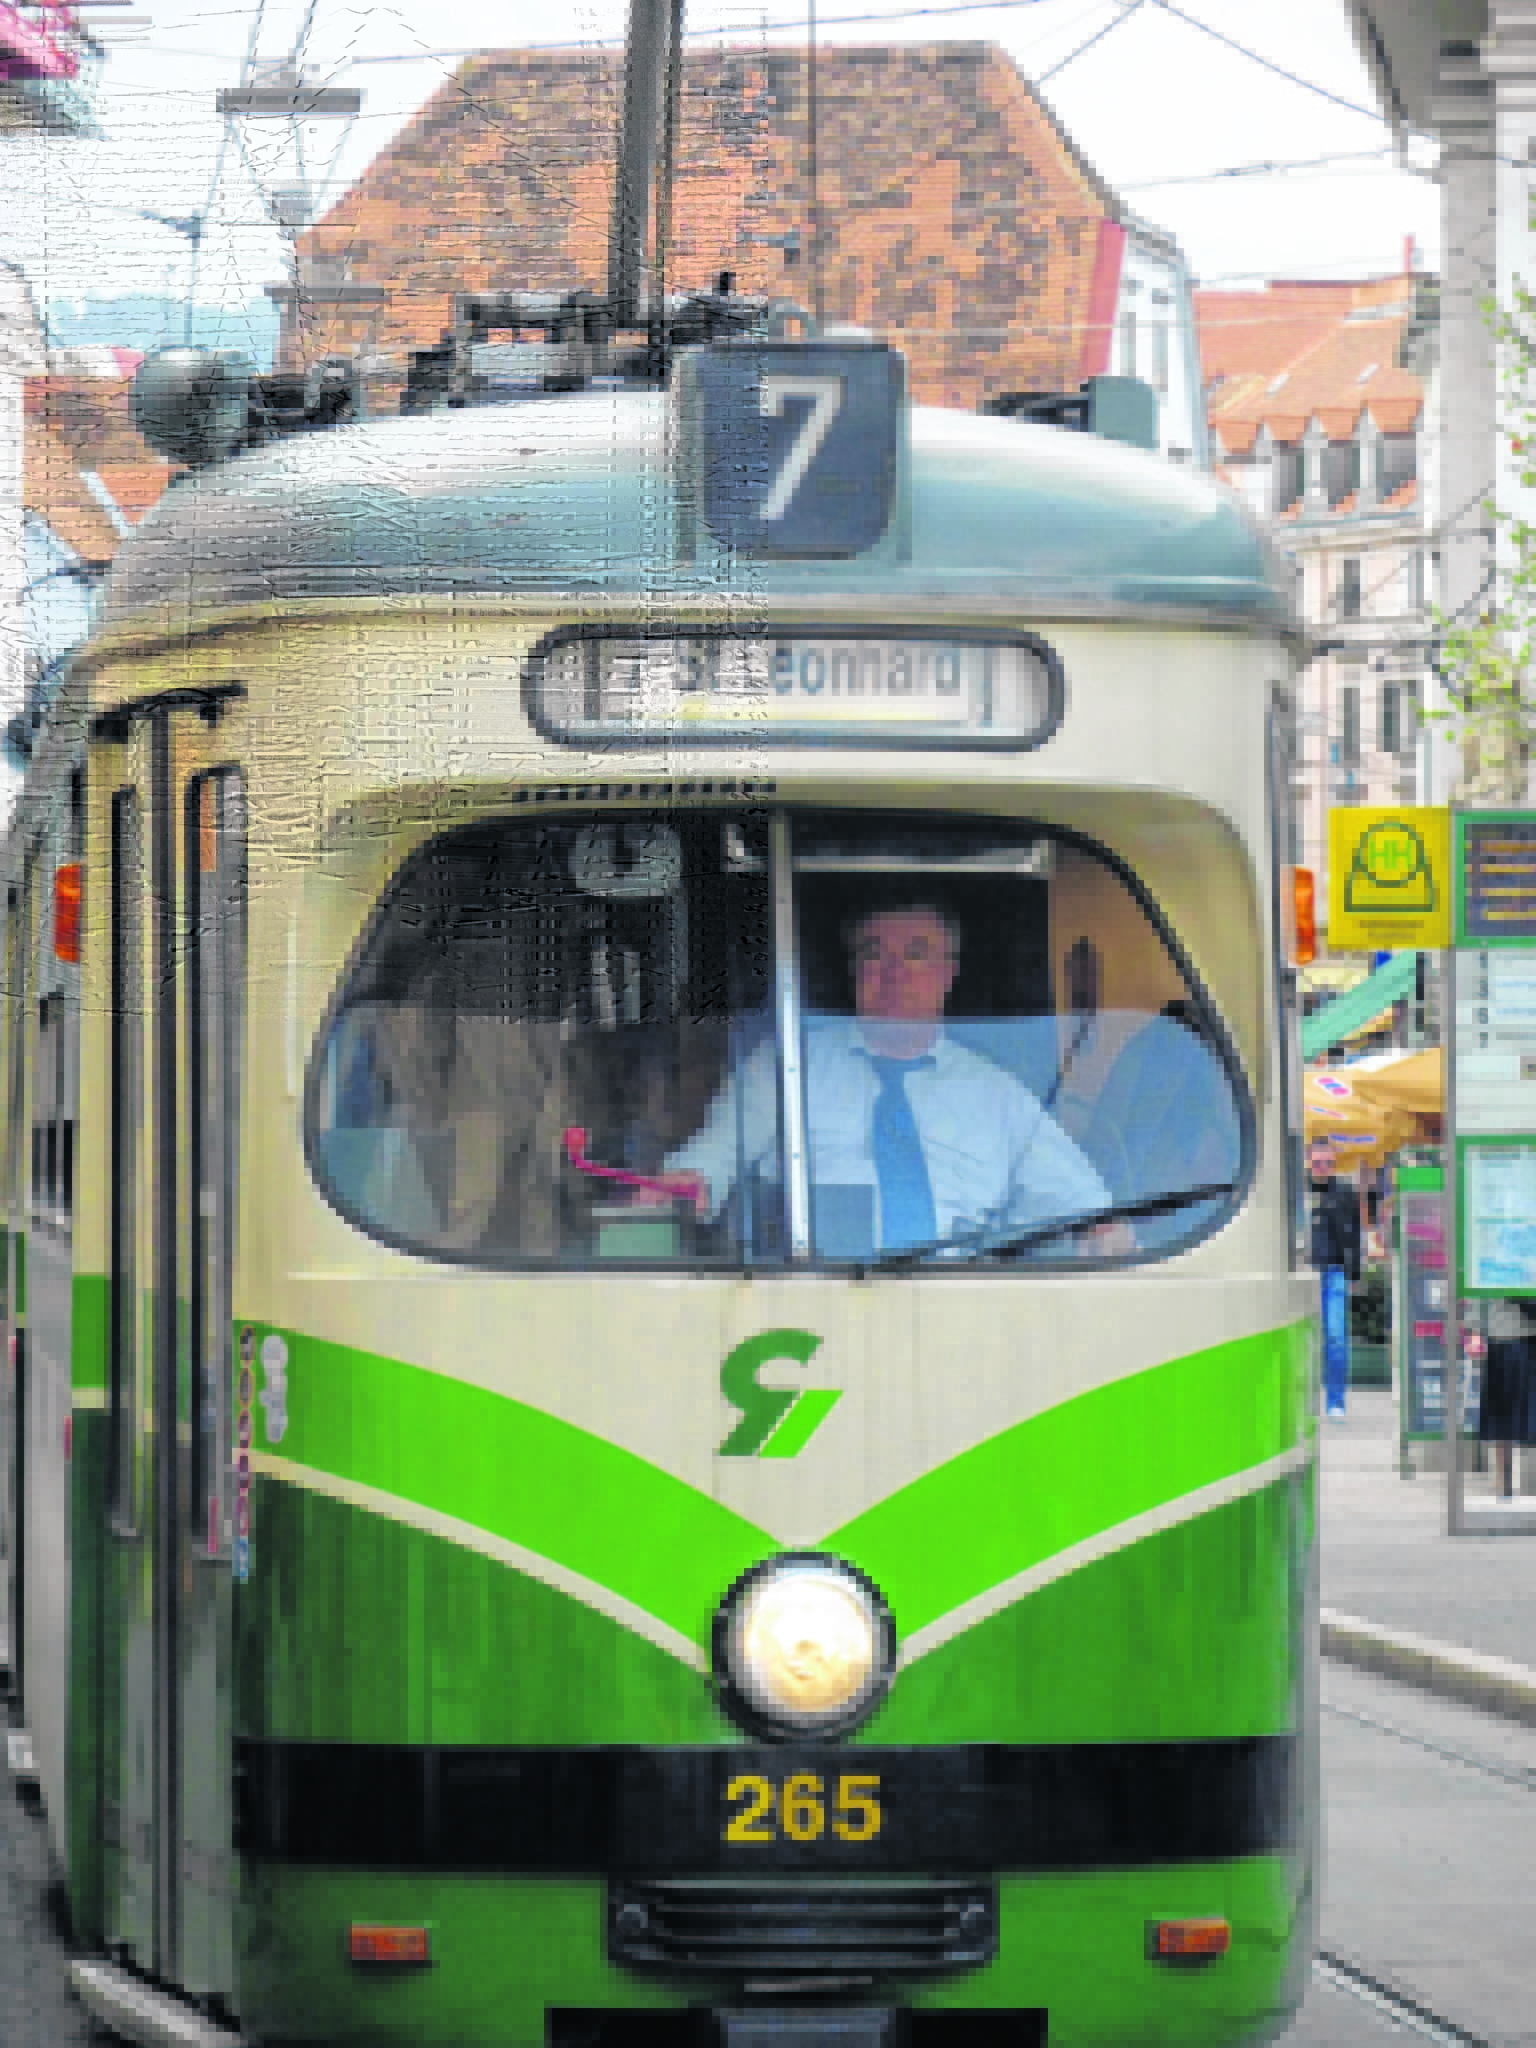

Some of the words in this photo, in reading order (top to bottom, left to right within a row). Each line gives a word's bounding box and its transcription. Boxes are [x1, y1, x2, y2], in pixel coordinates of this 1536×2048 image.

[758, 375, 844, 520] 7
[1477, 980, 1489, 997] 3
[1477, 1006, 1489, 1024] 6
[1477, 1033, 1489, 1051] 7
[725, 1774, 882, 1842] 265
